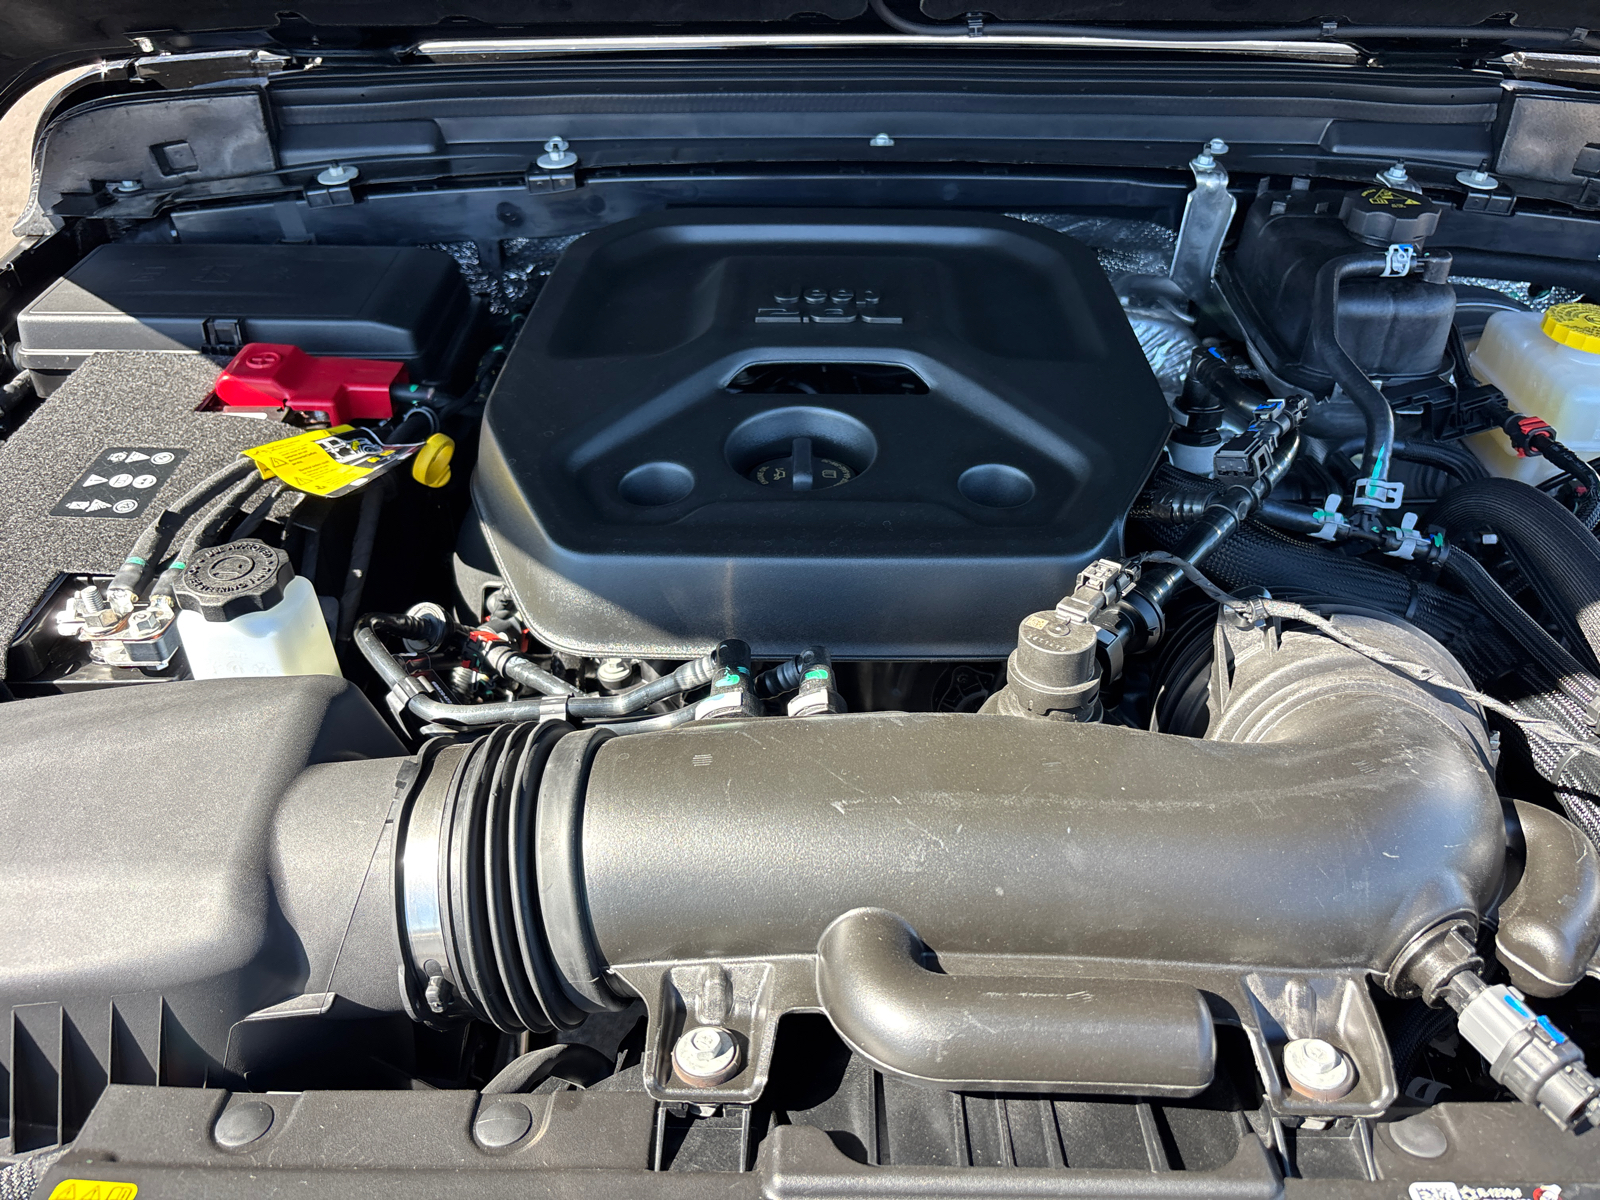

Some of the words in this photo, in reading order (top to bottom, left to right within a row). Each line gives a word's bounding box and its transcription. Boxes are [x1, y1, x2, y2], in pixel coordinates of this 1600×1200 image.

[774, 286, 880, 306] Jeep
[754, 308, 904, 324] 2.0L
[228, 543, 273, 558] APPROVED
